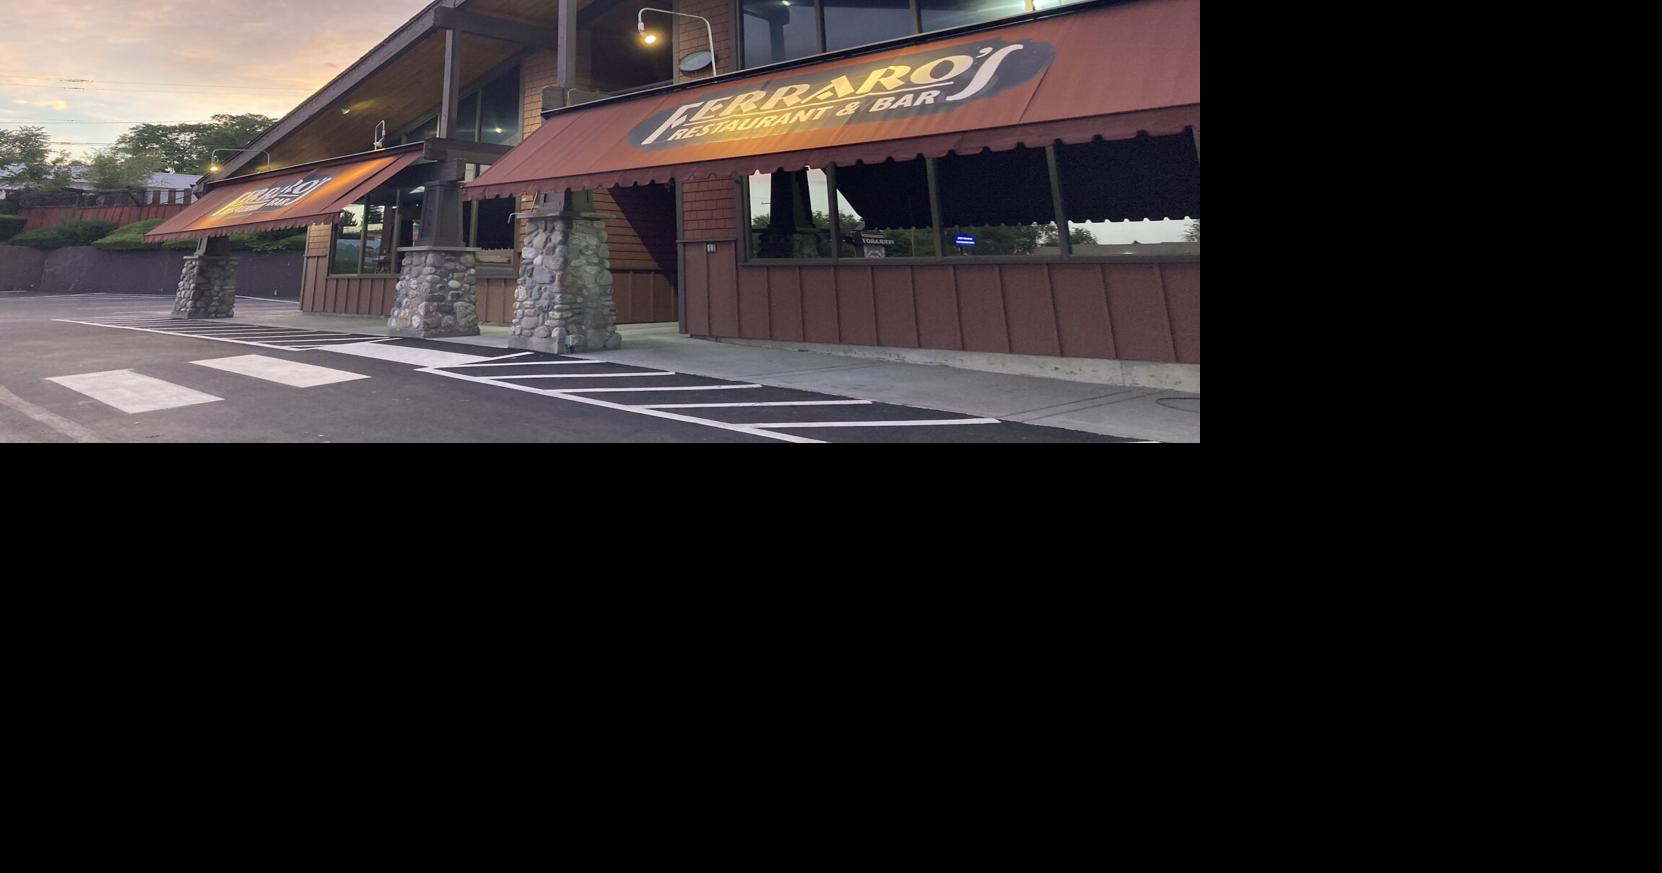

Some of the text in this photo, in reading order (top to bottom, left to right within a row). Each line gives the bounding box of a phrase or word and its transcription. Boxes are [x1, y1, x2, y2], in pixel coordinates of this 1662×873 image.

[640, 43, 1024, 145] FERRARO'S
[667, 90, 941, 141] RESTAURANT & BAR
